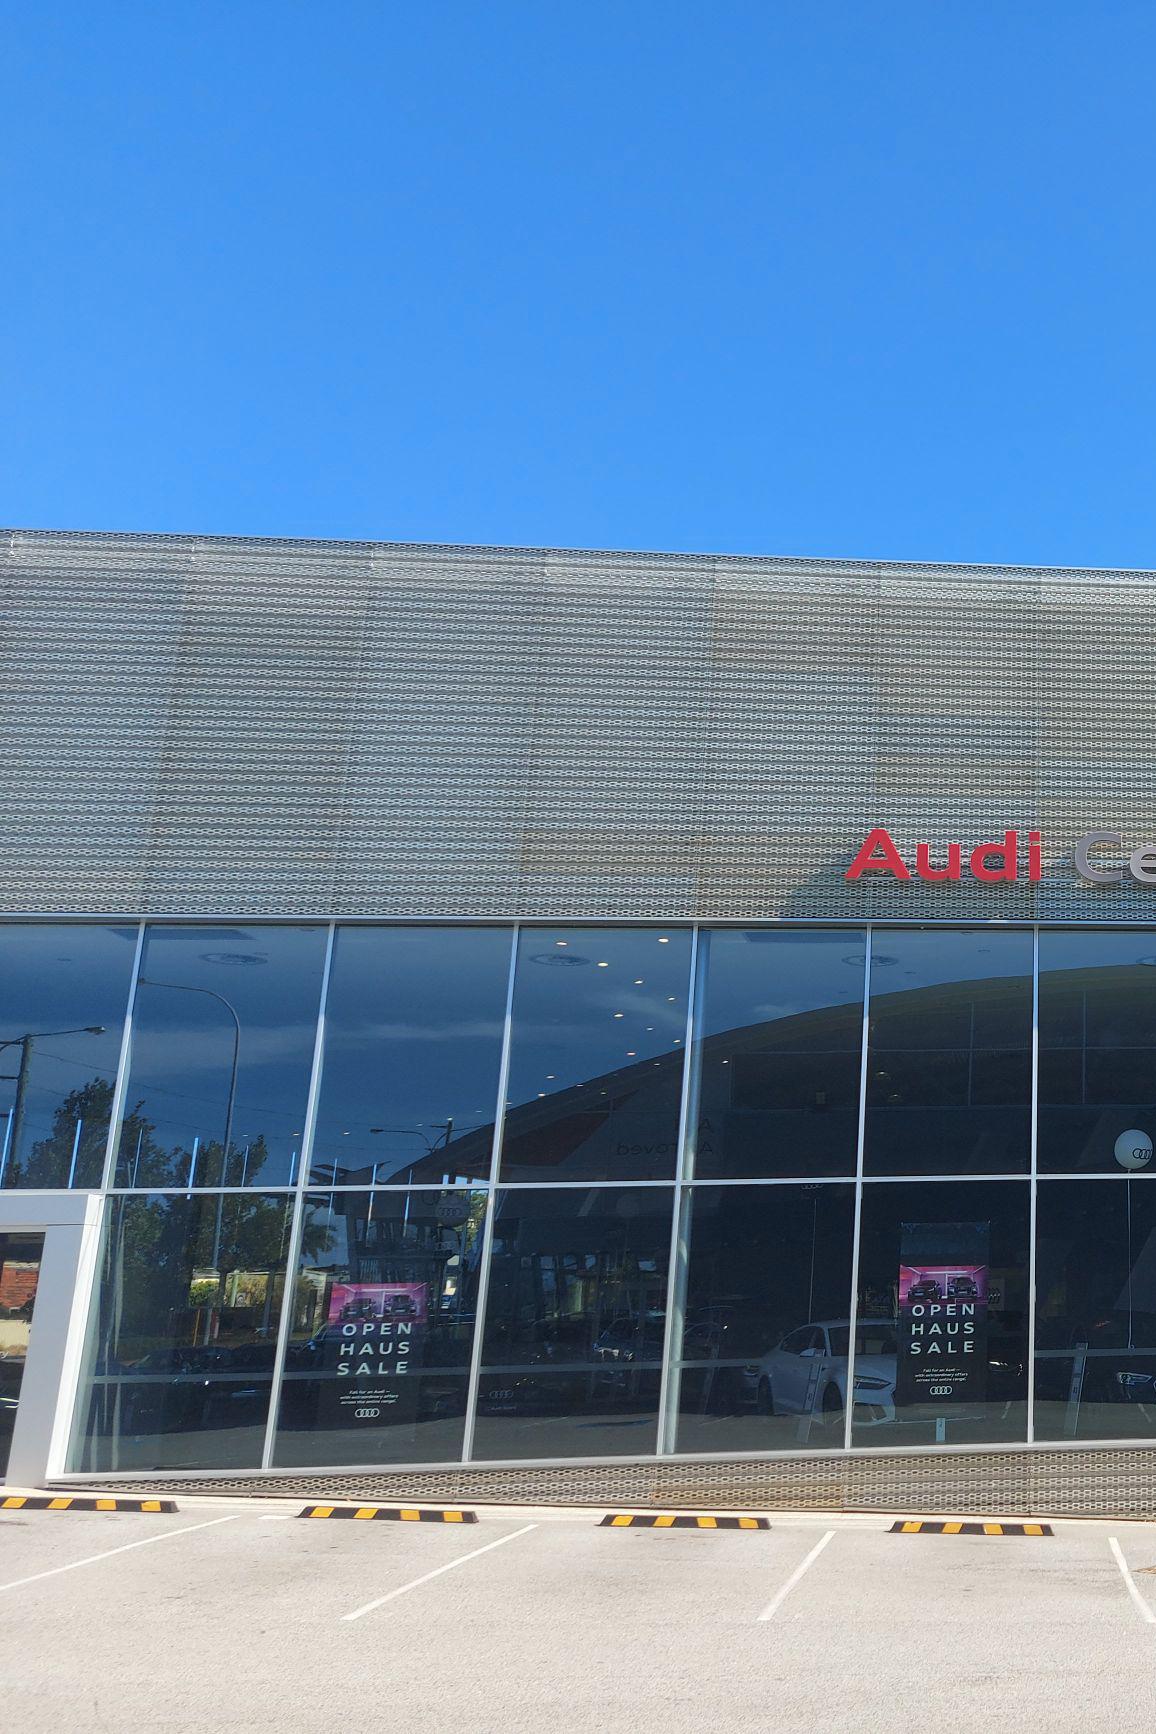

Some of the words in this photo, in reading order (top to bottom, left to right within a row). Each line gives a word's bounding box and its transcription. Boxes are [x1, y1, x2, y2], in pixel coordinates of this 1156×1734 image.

[845, 828, 1043, 882] Audi
[912, 1303, 975, 1317] OPEN
[342, 1322, 412, 1337] OPEN
[911, 1321, 975, 1336] HAUS
[340, 1341, 411, 1356] HAUS
[910, 1340, 975, 1355] SALE
[336, 1361, 409, 1376] SALE
